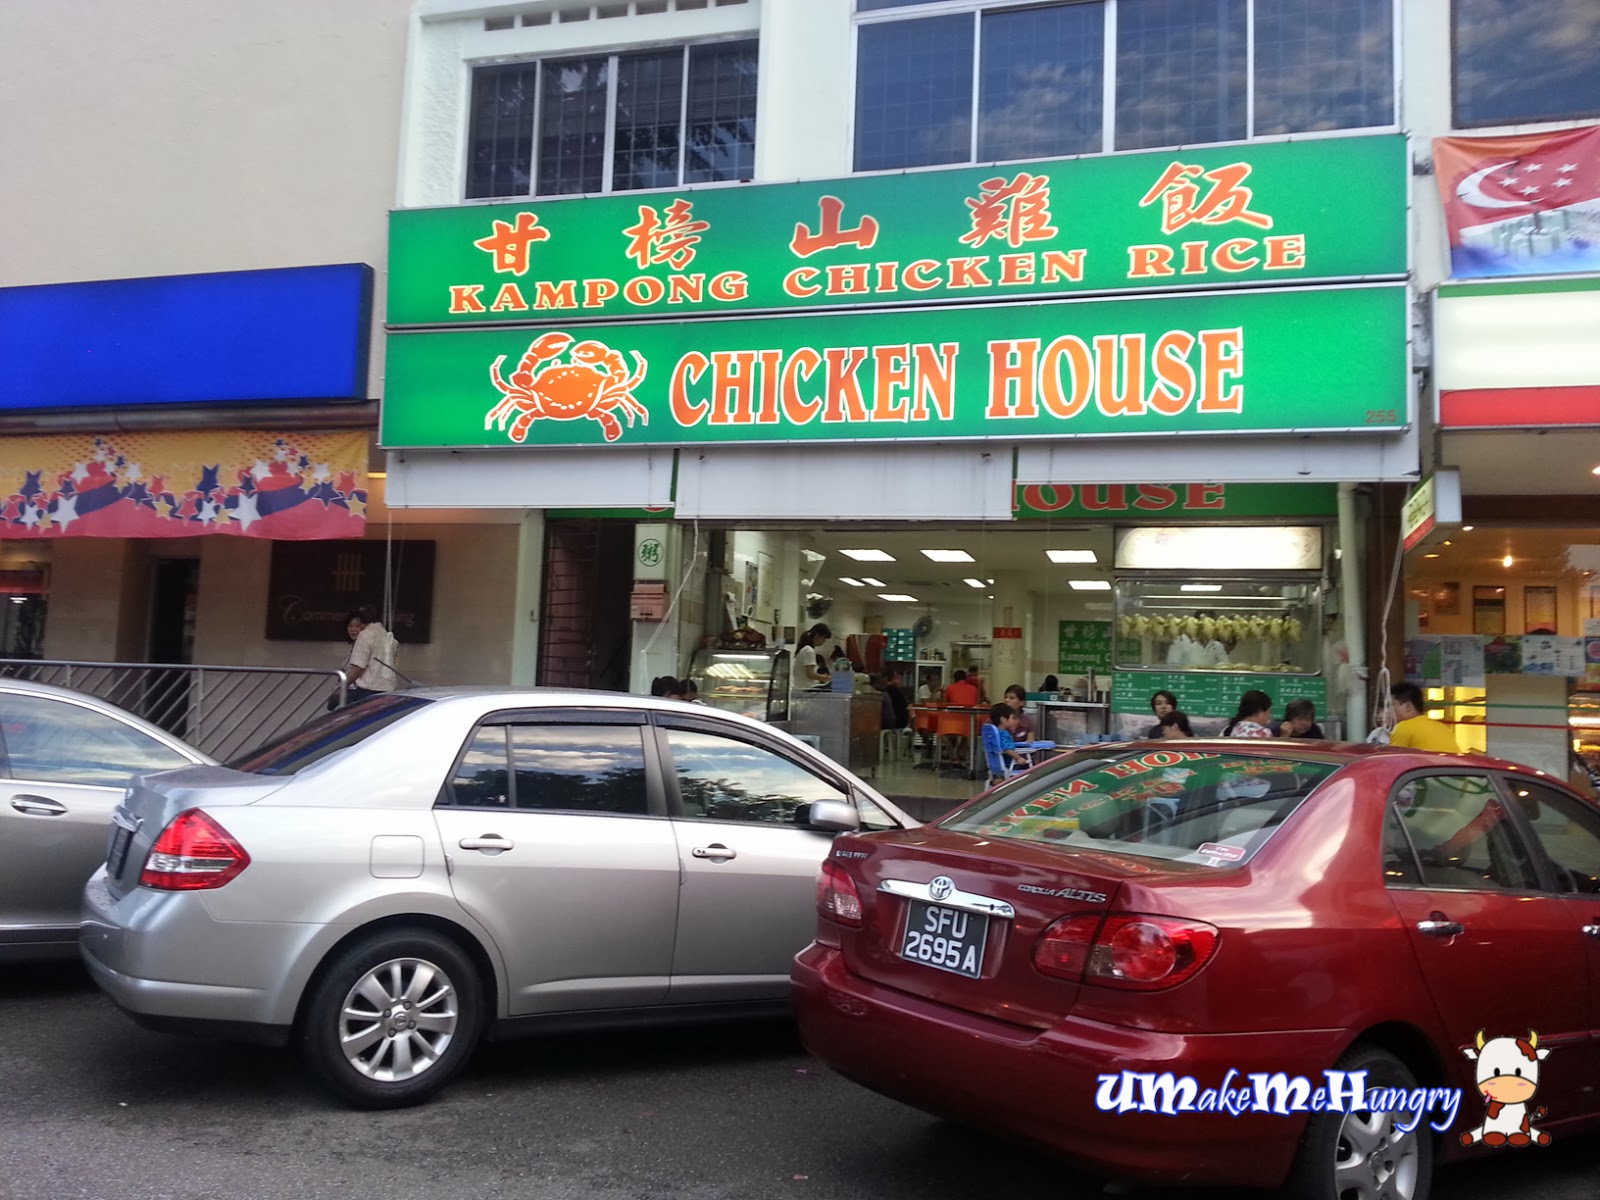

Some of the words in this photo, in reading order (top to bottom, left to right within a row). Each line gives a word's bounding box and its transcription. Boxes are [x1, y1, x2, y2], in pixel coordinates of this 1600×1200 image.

[473, 160, 1274, 277] 甘榜山雞飯
[449, 271, 750, 315] KAMPONG
[783, 248, 1087, 298] CHICKEN
[1127, 233, 1306, 279] RICE
[669, 342, 960, 428] CHICKEN
[986, 327, 1244, 420] HOUSE
[1365, 410, 1397, 424] 255
[1012, 482, 1225, 511] OUSE
[1055, 888, 1107, 904] ALTIS
[924, 906, 969, 939] SFU
[905, 932, 976, 974] 2695A
